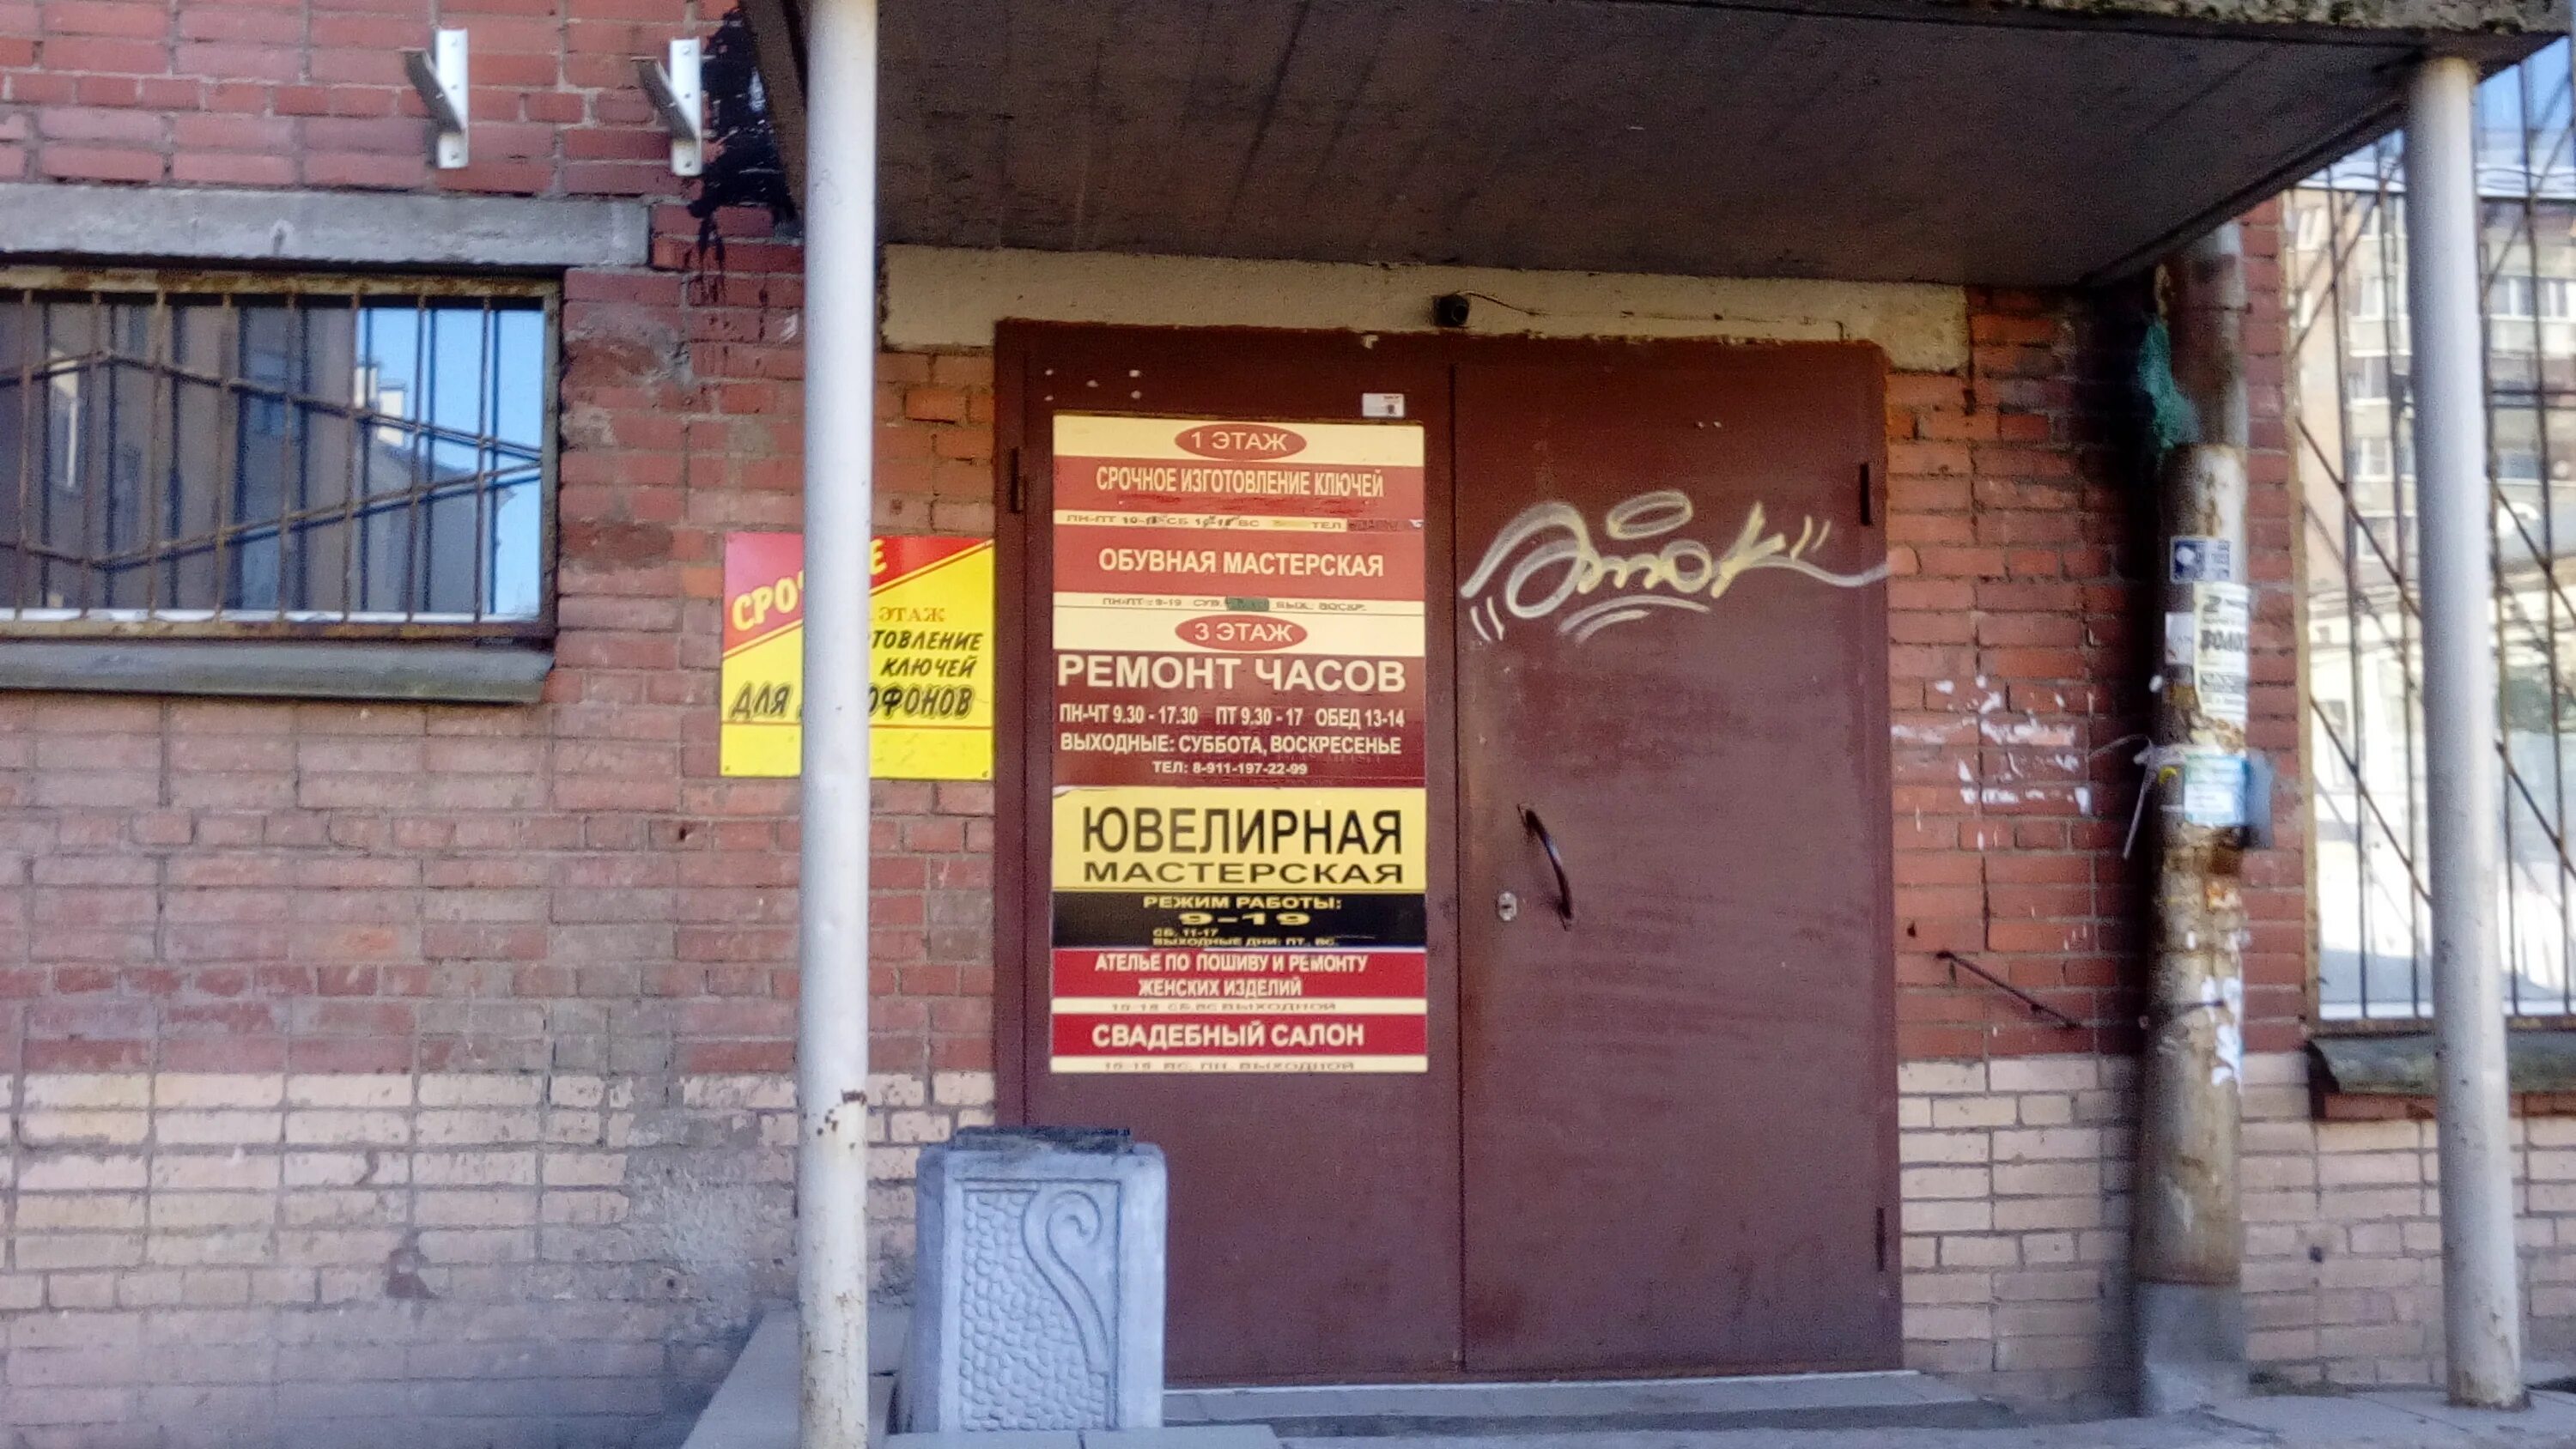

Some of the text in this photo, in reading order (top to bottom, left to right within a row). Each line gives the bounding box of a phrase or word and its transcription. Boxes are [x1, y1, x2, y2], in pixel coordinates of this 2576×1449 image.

[1190, 432, 1288, 451] 1 ЭТАЖ
[1097, 467, 1384, 497] СРОЧНОЕ ИЗГОТОВЛЕНИЕ КЛЮЧЕЙ
[1066, 514, 1116, 524] ПН-ПТ
[1098, 547, 1384, 577] ОБУВНАЯ МАСТЕРСКАЯ
[878, 606, 947, 622] ЭТАЖ
[870, 630, 984, 652] ТОВЛЕНИЕ
[1194, 622, 1294, 642] 3 ЭТАЖ
[879, 655, 979, 679] КЛЮЧЕЙ
[1057, 655, 1406, 693] РЕМОНТ ЧАСОВ
[731, 683, 792, 718] ДЛЯ
[1059, 704, 1109, 724] ПН-ЧТ
[1112, 705, 1145, 724] 9.30
[1158, 706, 1199, 725] 17.30
[1215, 706, 1238, 726] ПТ
[1241, 706, 1273, 726] 9.30
[1285, 707, 1303, 727] 17
[1315, 708, 1362, 731] ОБЕД
[1364, 709, 1406, 728] 13-14
[1060, 731, 1402, 756] ВЫХОДНЫЕ: СУББОТА, ВОСКРЕСЕНЬЕ
[1152, 761, 1309, 775] ТЕЛ: 8-911-197-22-99
[1082, 806, 1402, 855] ЮВЕЛИРНАЯ
[1083, 861, 1404, 884] МАСТЕРСКАЯ
[1143, 895, 1342, 910] РЕЖИМ РАБОТЫ:
[1178, 911, 1311, 926] 9-19
[1182, 928, 1219, 937] 11-17
[1095, 953, 1369, 973] АТЕЛЬЕ ПО ПОШИВУ И РЕМОНТУ
[1139, 977, 1303, 998] ЖЕНСКИХ ИЗДЕЛИЙ
[1091, 1021, 1365, 1051] СВАДЕБНЫЙ САЛОН
